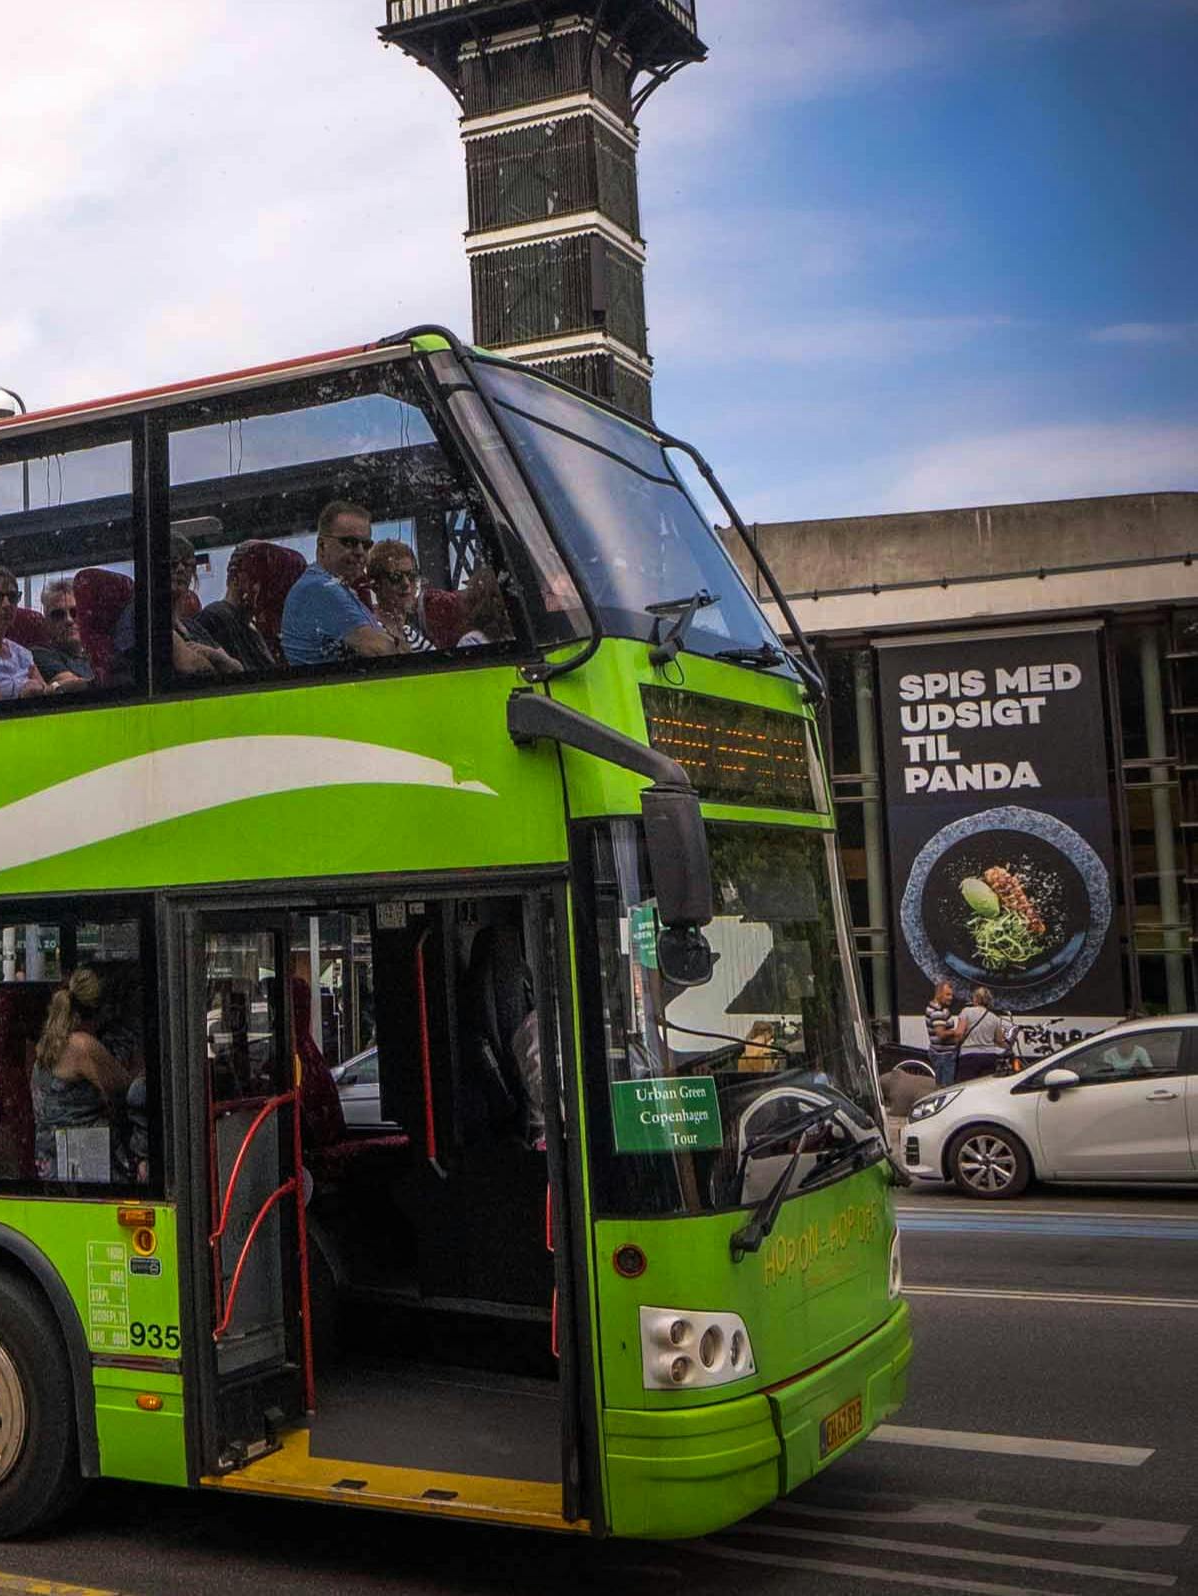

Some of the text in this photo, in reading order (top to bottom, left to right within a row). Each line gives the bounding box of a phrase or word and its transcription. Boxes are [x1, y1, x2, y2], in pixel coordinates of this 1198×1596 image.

[899, 663, 1082, 702] SPIS MED
[900, 696, 1047, 732] UDSIGT
[901, 734, 961, 763] TIL
[904, 760, 1042, 794] PANDA
[635, 1085, 707, 1101] Urban Green
[640, 1108, 708, 1128] Copenhagen
[669, 1131, 698, 1145] Tour
[764, 1235, 795, 1287] HOP
[800, 1222, 819, 1272] ON
[829, 1206, 856, 1256] HOP
[129, 1321, 180, 1350] 935
